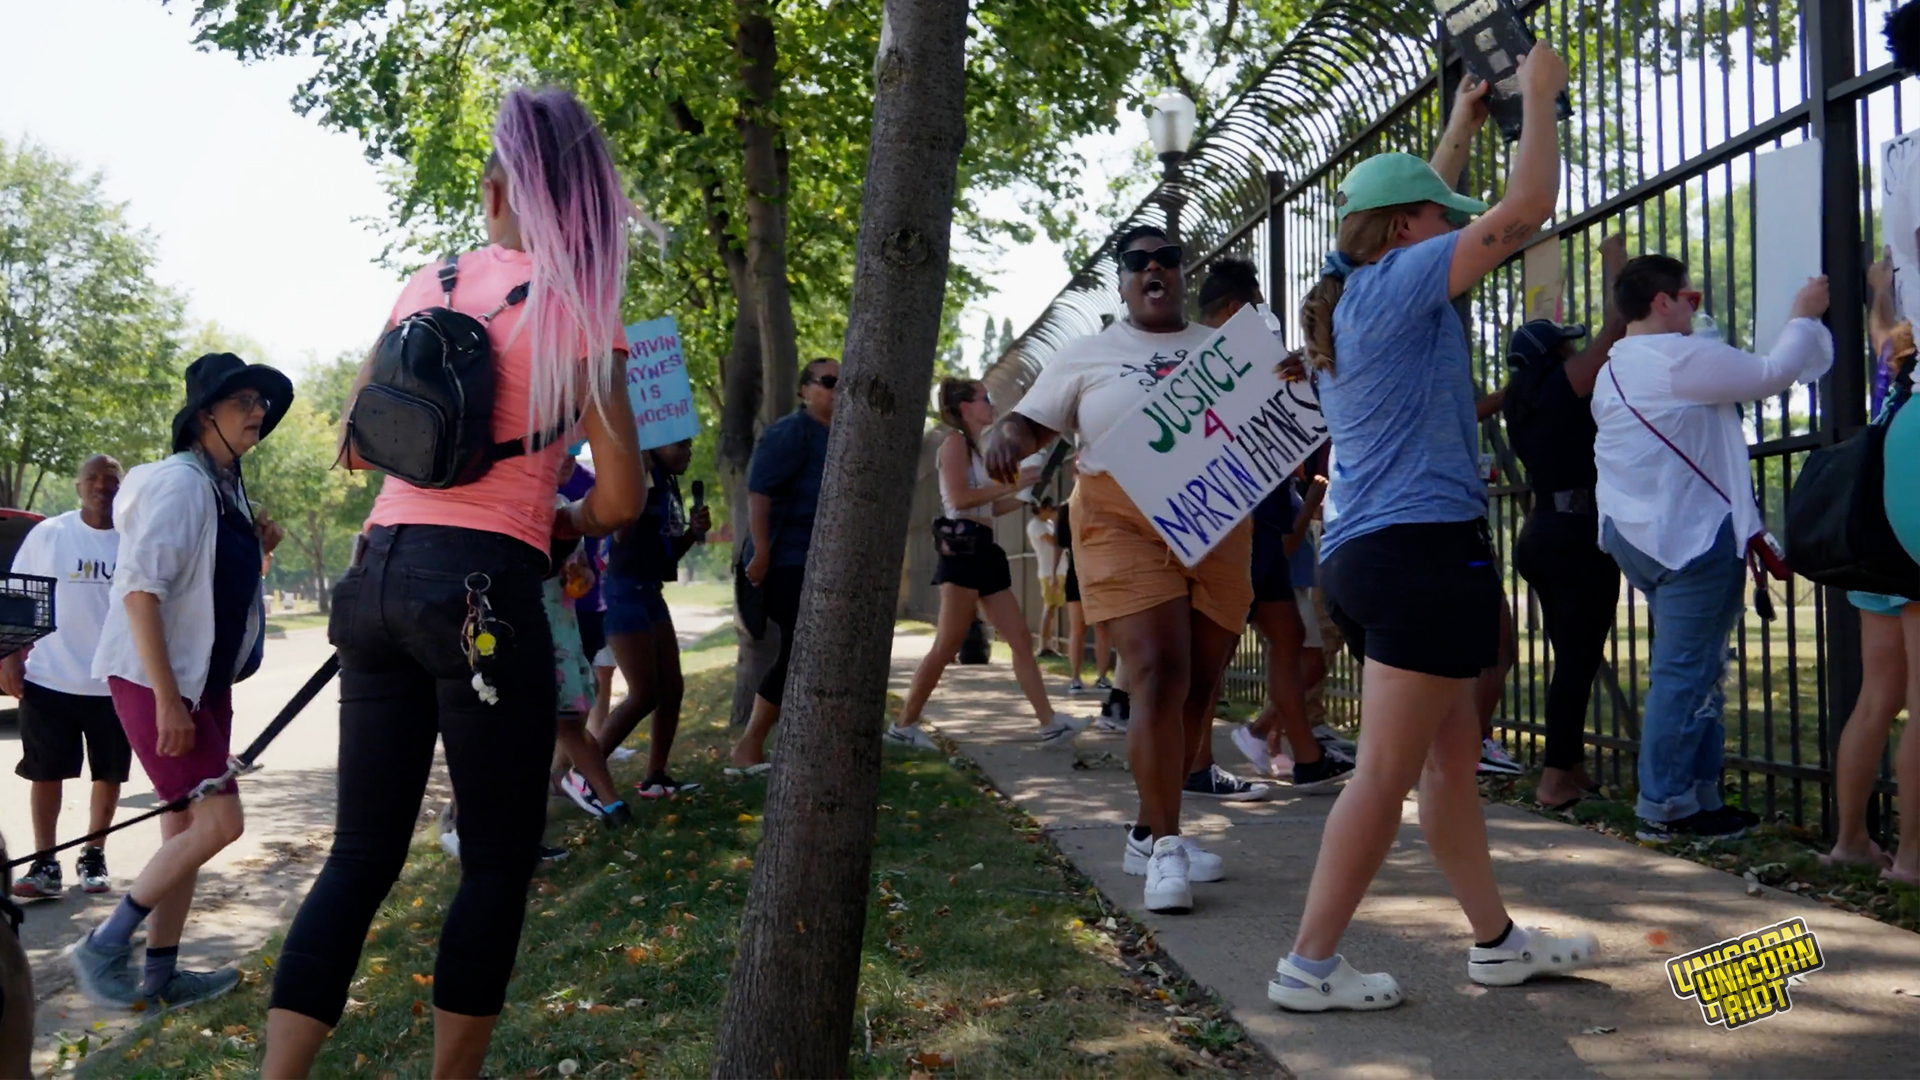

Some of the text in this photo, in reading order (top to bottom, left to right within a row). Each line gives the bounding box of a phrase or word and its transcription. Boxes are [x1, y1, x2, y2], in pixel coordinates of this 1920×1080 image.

[640, 384, 661, 403] IS
[1204, 408, 1236, 443] 4
[1153, 444, 1264, 557] MARVIN
